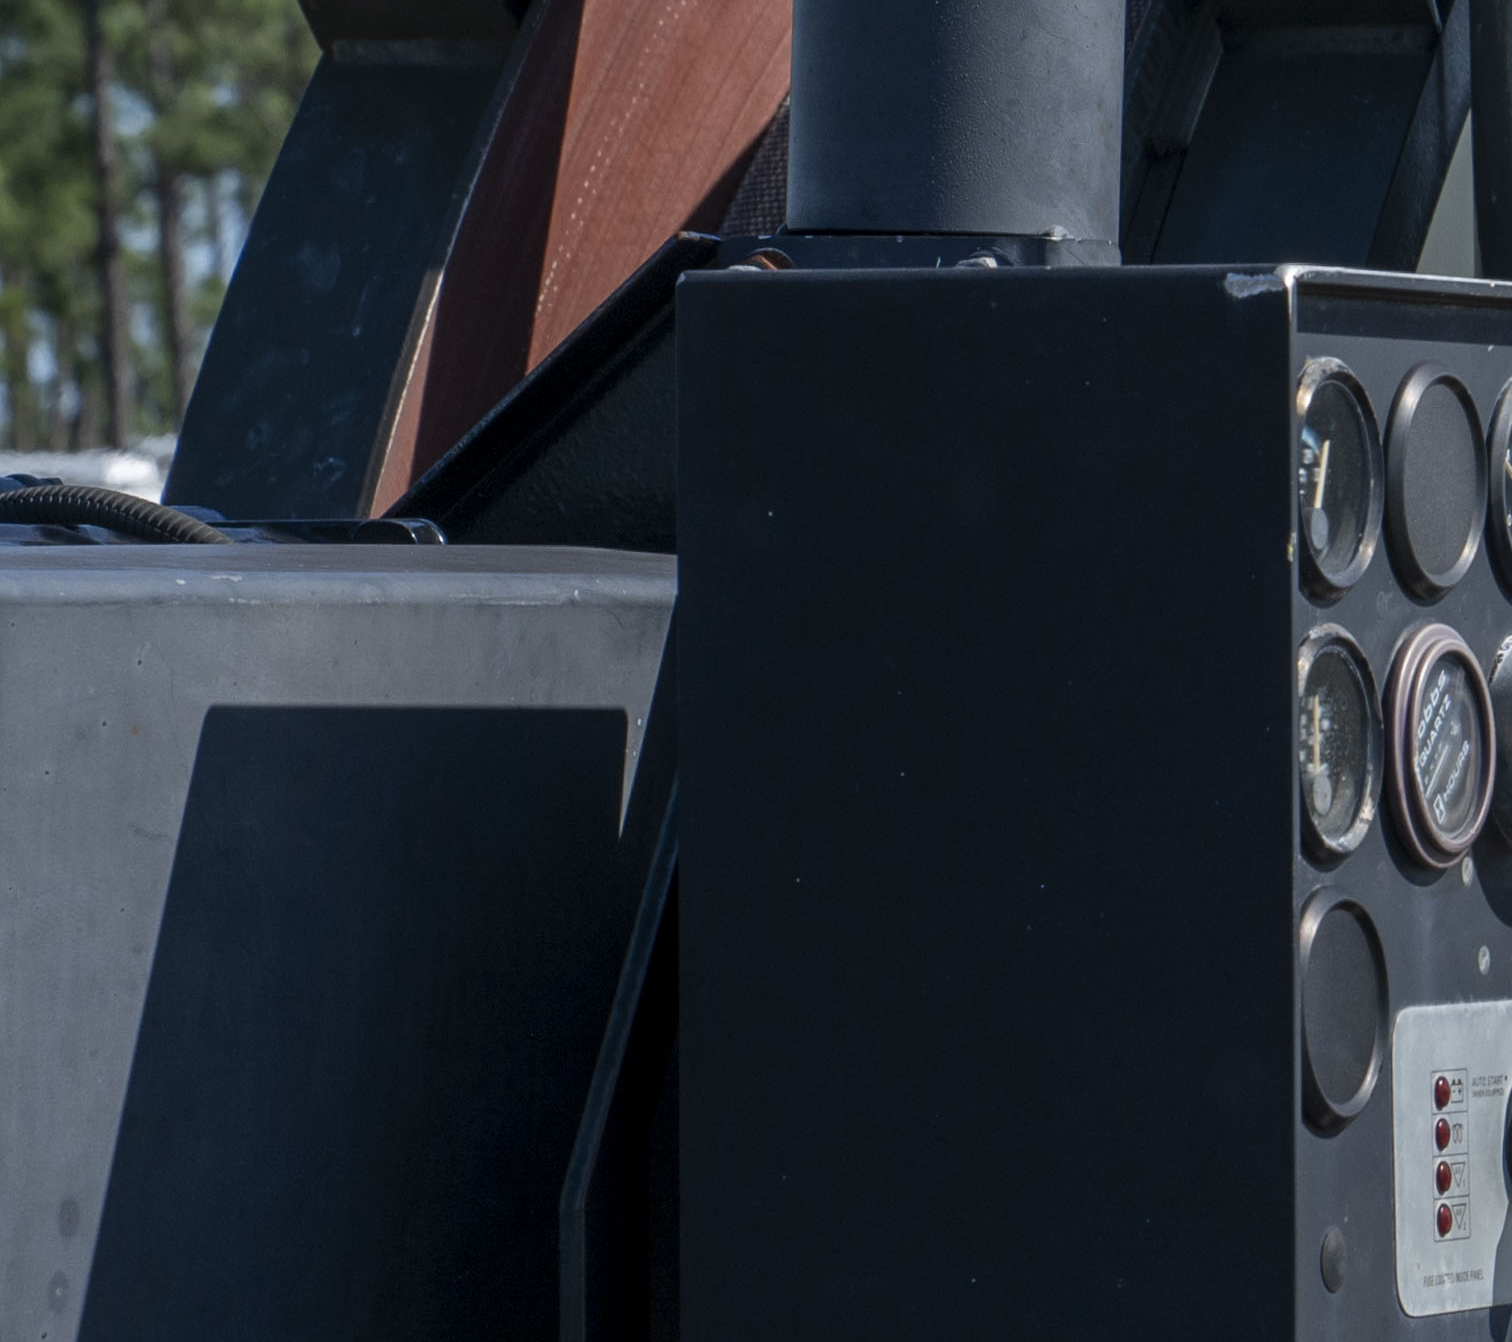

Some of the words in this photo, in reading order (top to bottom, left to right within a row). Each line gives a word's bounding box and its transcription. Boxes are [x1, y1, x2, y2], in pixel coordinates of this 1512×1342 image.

[1417, 669, 1448, 739] obbs
[1419, 693, 1452, 768] QUARTZ
[1442, 739, 1470, 802] HOURS
